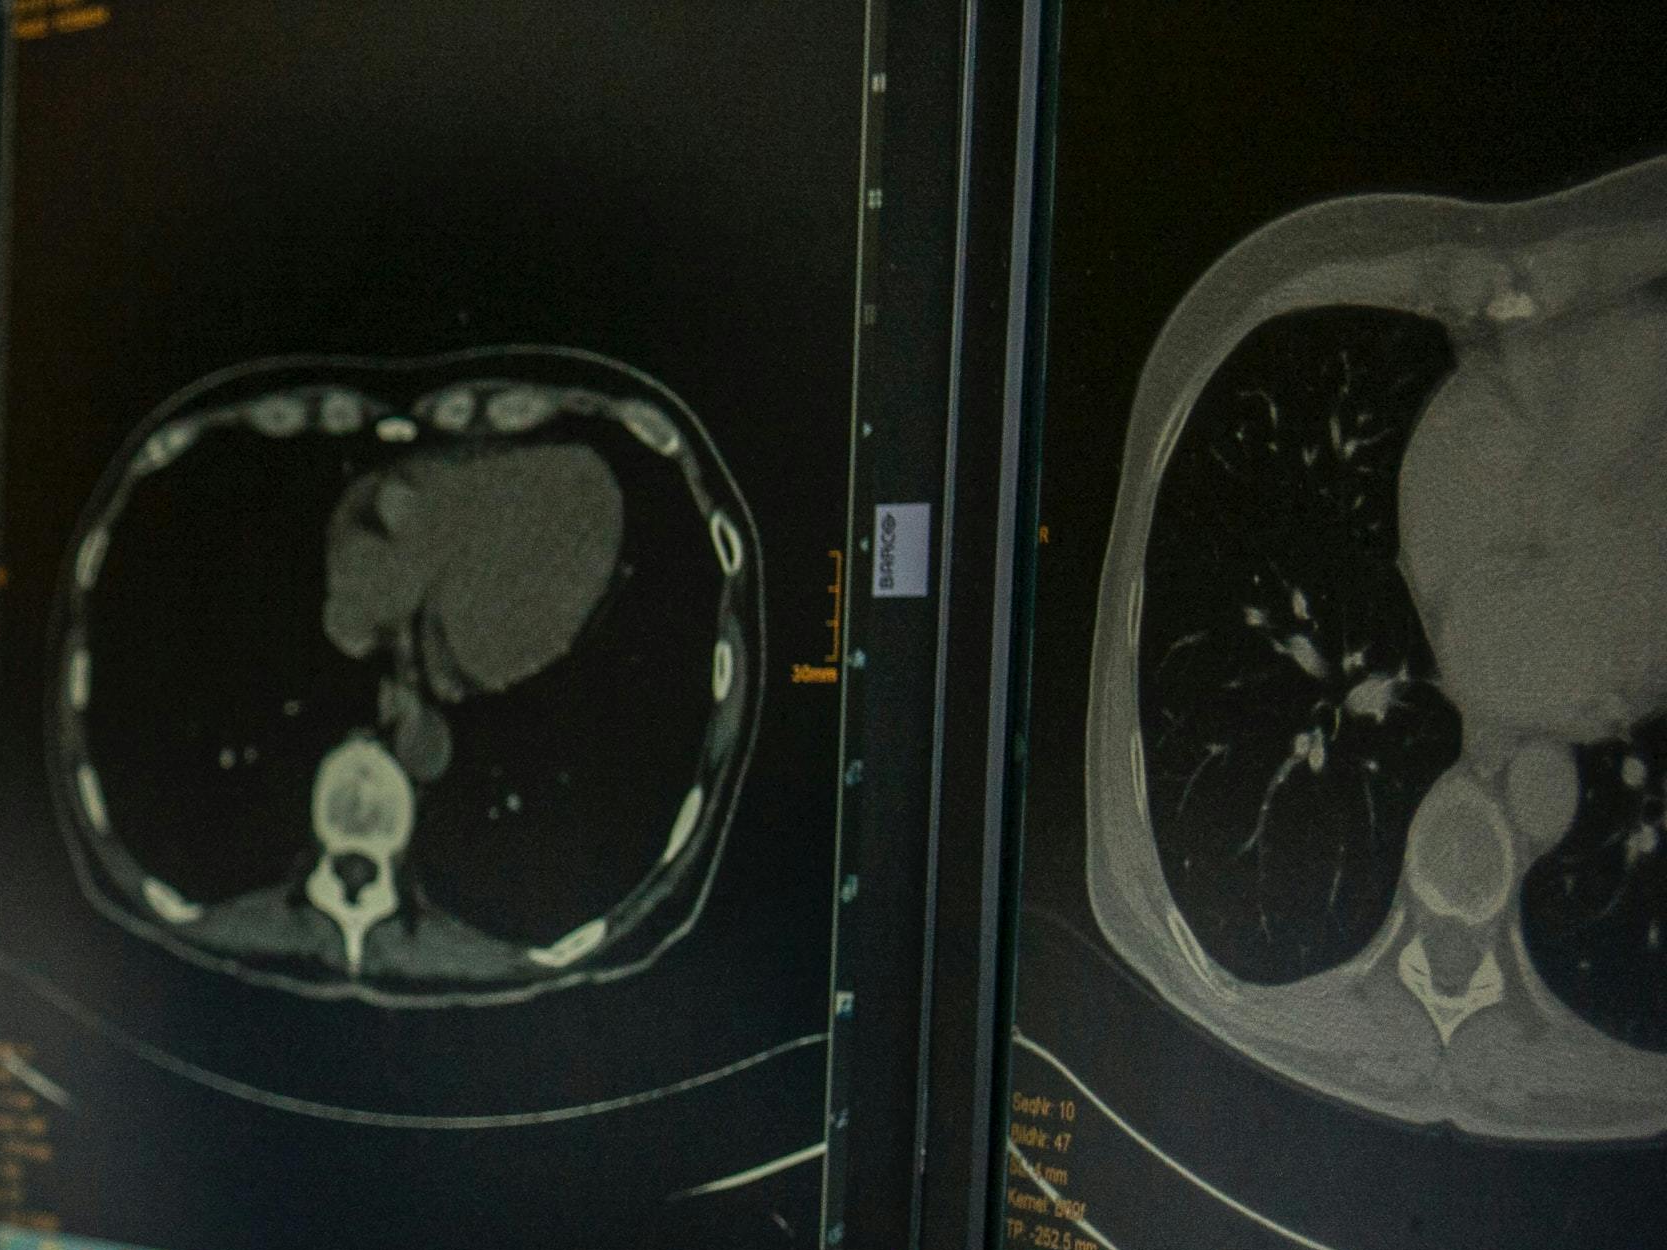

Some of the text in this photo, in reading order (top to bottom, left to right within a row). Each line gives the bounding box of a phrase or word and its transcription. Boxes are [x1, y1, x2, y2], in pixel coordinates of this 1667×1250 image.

[878, 513, 897, 590] BARCO
[1060, 1100, 1076, 1121] 10
[1054, 1132, 1072, 1153] 47
